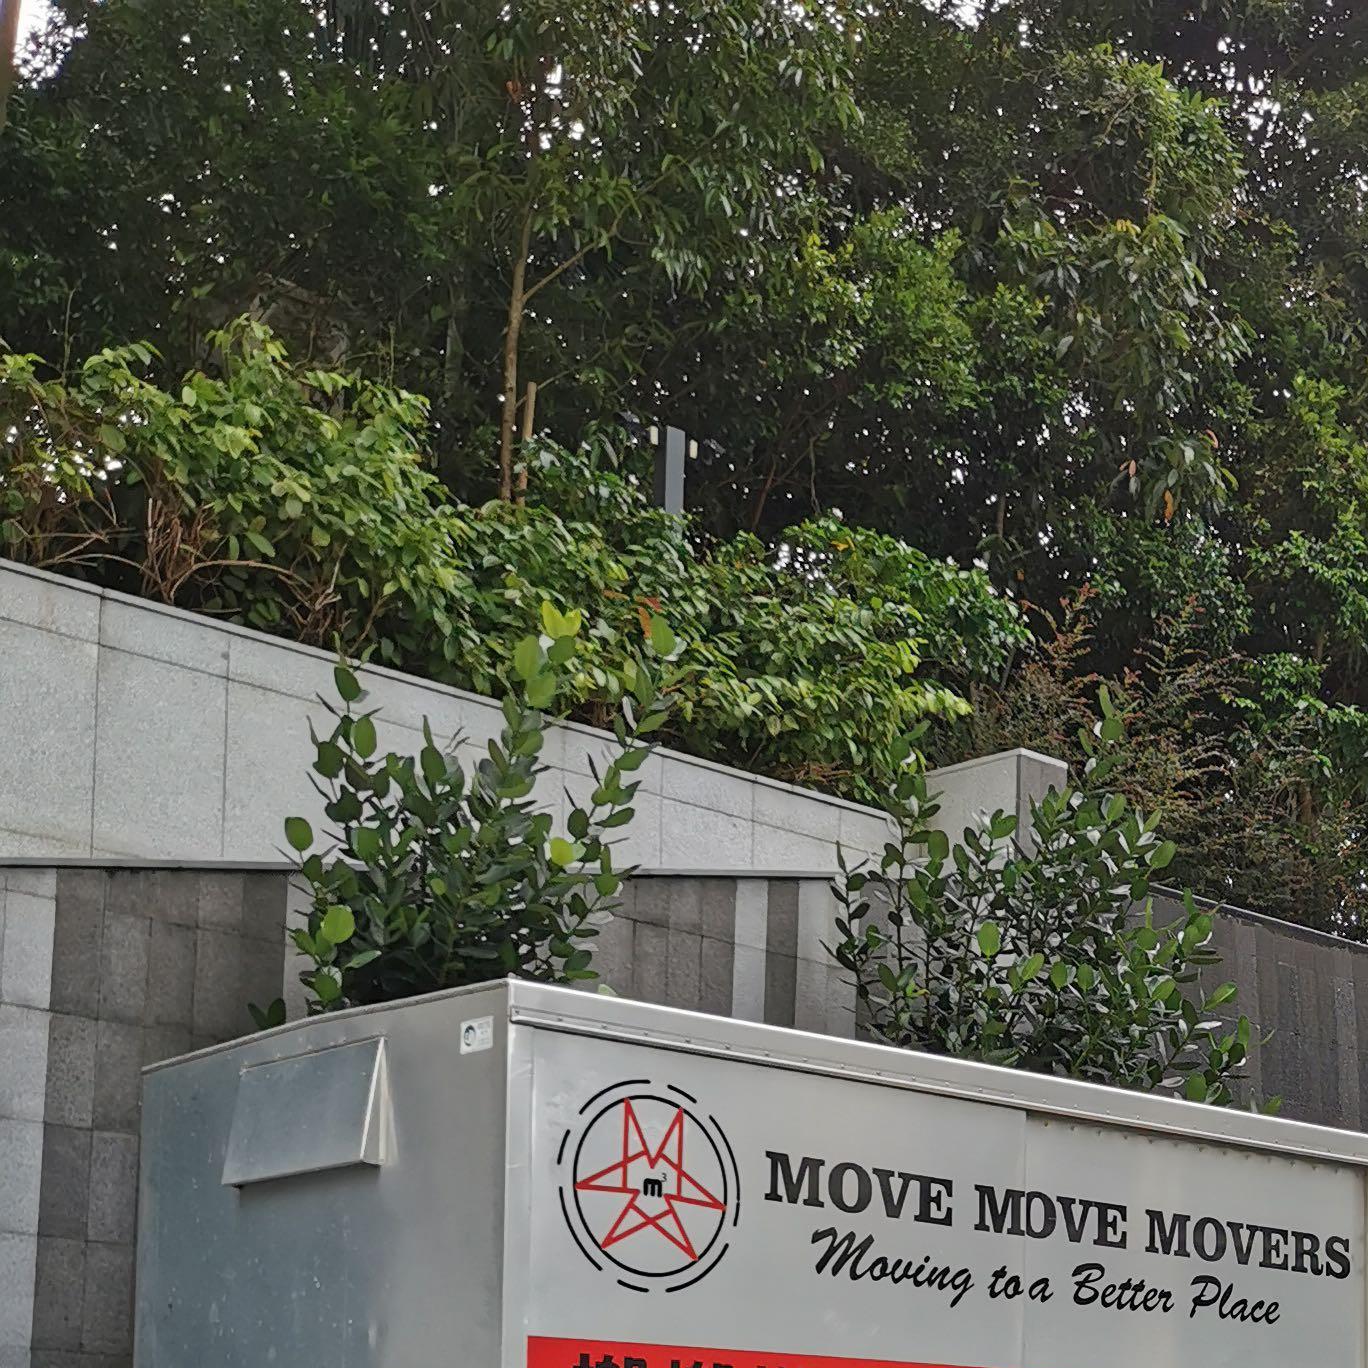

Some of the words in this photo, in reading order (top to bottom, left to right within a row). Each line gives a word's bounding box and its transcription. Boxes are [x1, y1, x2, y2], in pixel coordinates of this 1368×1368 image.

[765, 1151, 954, 1227] MOVE
[974, 1184, 1128, 1249] MOVE
[1145, 1209, 1351, 1280] MOVERS
[811, 1227, 975, 1308] Moving
[988, 1265, 1024, 1299] to
[1028, 1277, 1054, 1303] a
[1072, 1263, 1175, 1313] Better
[1190, 1275, 1281, 1325] Place
